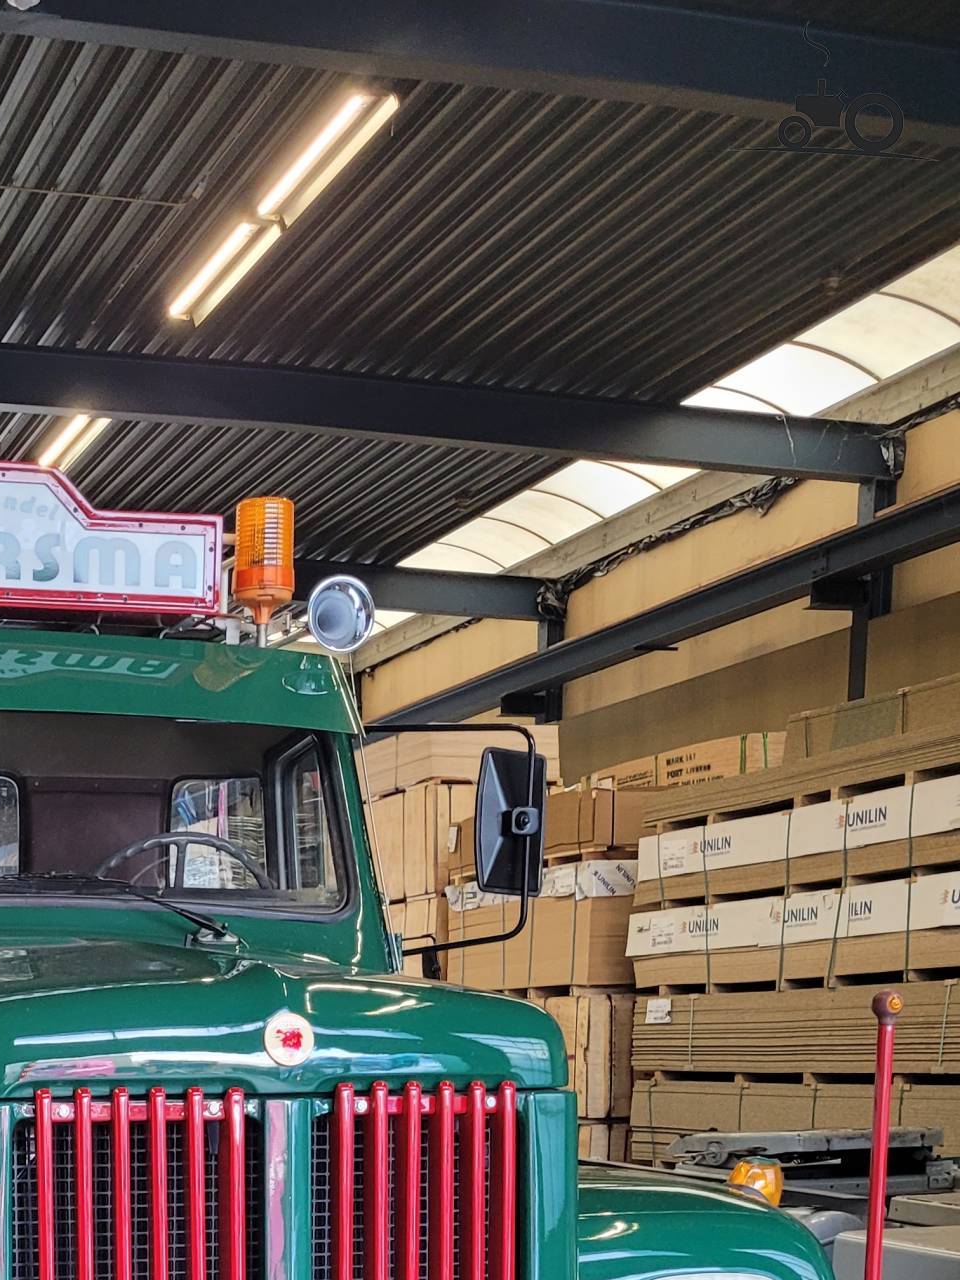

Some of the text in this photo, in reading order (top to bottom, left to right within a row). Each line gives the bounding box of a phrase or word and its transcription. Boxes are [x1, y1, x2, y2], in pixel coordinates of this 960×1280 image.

[847, 806, 887, 827] UNILIN
[700, 836, 732, 853] UNILIN
[784, 906, 818, 923] UNILIN
[849, 900, 872, 917] ILIN
